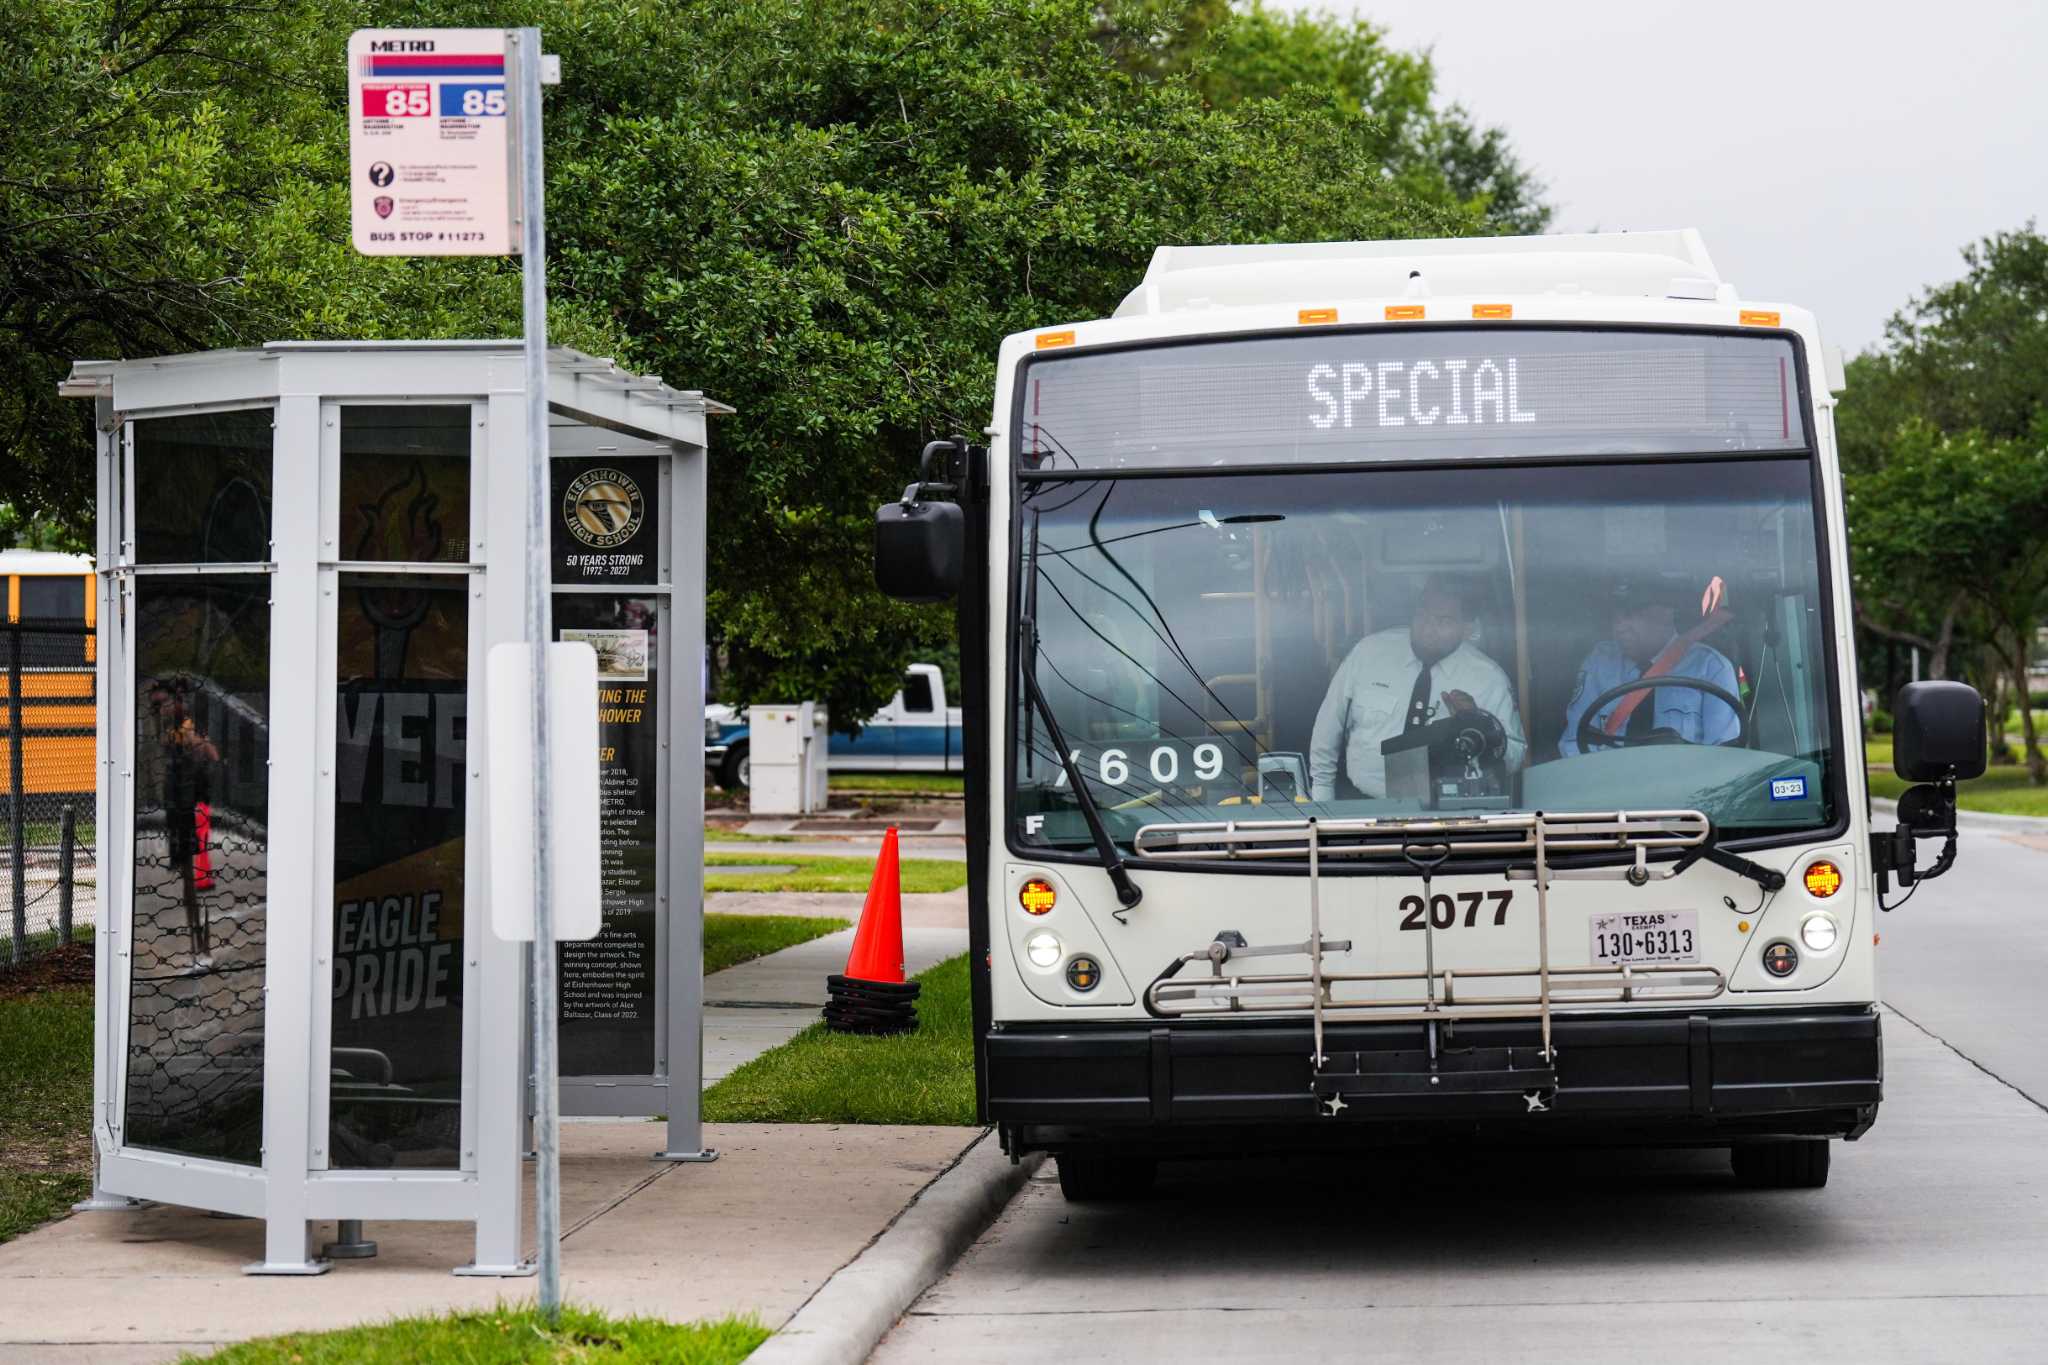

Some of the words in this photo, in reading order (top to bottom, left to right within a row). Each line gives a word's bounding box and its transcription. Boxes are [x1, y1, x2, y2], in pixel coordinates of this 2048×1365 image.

[370, 40, 435, 53] METRO
[385, 89, 430, 116] 85
[462, 89, 506, 116] 85
[370, 232, 396, 241] BUS
[400, 232, 434, 241] STOP
[438, 231, 485, 241] #11273
[1308, 358, 1536, 428] SPECIAL
[567, 470, 640, 502] EISENHOWER
[567, 515, 594, 543] HIGH
[596, 517, 640, 545] SCHOOL
[566, 554, 578, 566] 50
[580, 554, 607, 566] YEARS
[608, 554, 644, 566] STRONG
[582, 566, 603, 576] (1972
[609, 566, 630, 576] 2022)
[625, 689, 648, 704] THE
[1025, 815, 1044, 835] F
[604, 888, 626, 897] Sergio
[1398, 890, 1513, 931] 2077
[338, 893, 441, 954] EAGLE
[1623, 914, 1665, 926] TEXAS
[563, 951, 586, 960] design
[628, 951, 641, 959] The
[563, 962, 590, 970] winning
[333, 943, 452, 1020] PRIDE
[615, 981, 631, 990] High
[616, 992, 643, 1000] inspired
[620, 1001, 634, 1009] Alex
